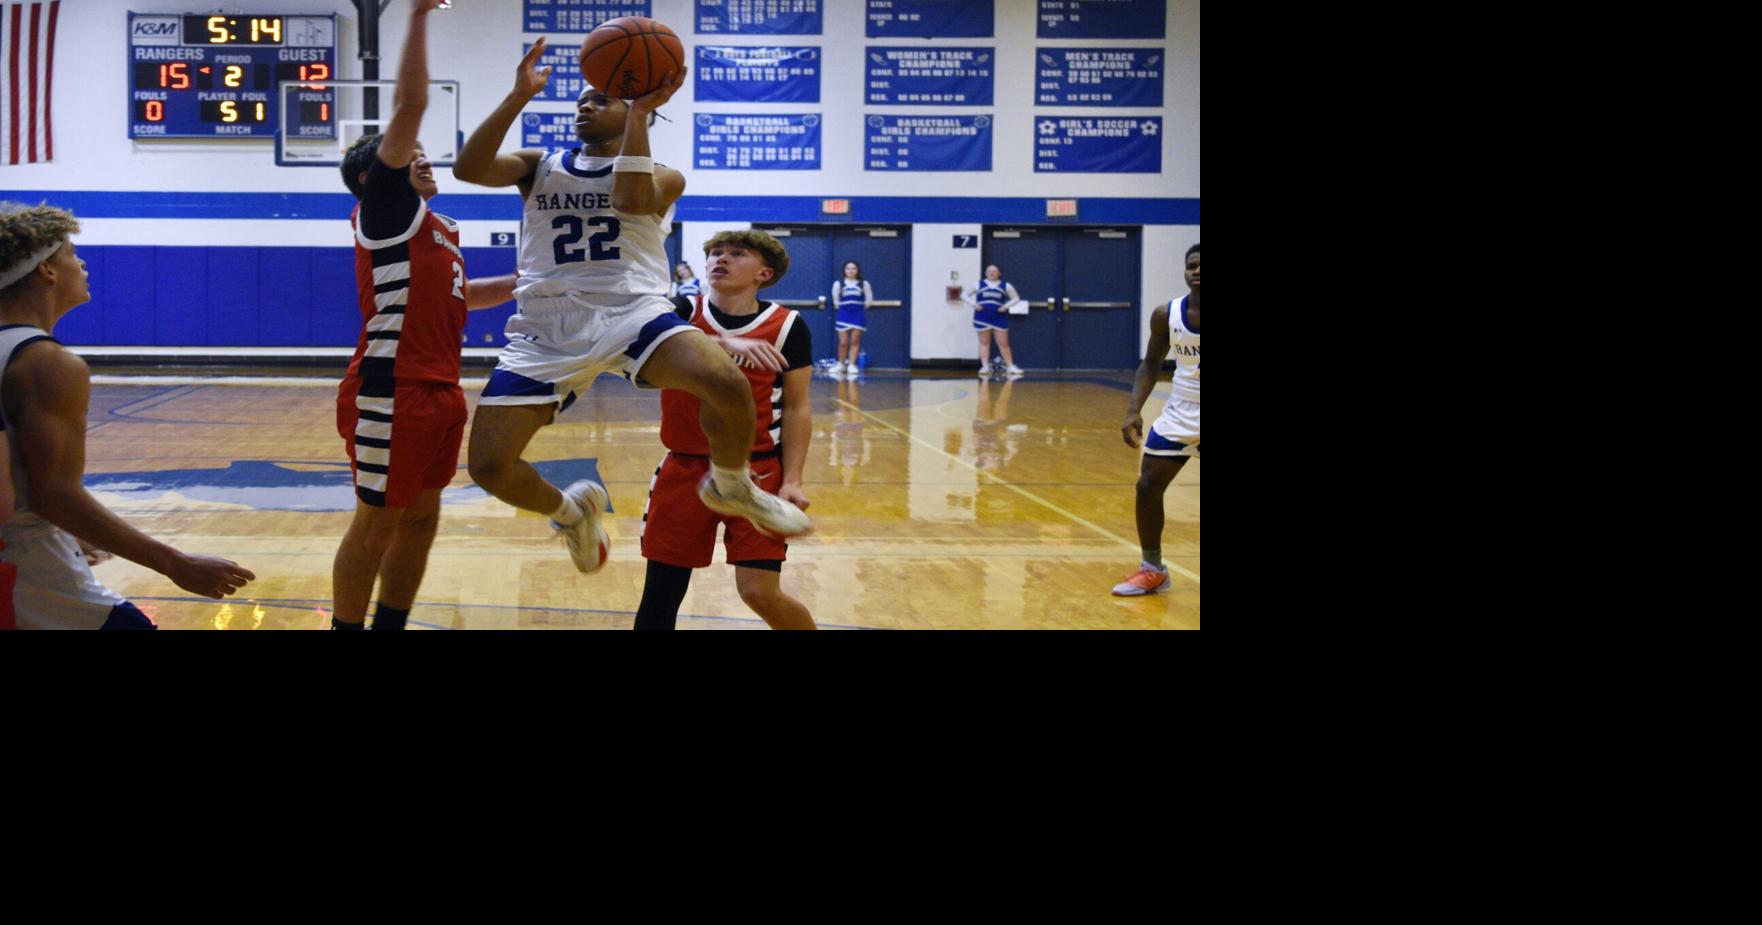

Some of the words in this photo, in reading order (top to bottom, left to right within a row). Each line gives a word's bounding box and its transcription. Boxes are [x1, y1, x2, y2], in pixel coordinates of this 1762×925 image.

[134, 22, 178, 35] K&M
[207, 16, 281, 43] 5:14
[135, 48, 205, 60] RANGERS
[278, 49, 328, 61] GUEST
[887, 51, 937, 60] WOMEN'S
[940, 51, 974, 60] TRACK
[1065, 52, 1099, 61] MEN'S
[1102, 52, 1135, 61] TRACK
[215, 55, 252, 63] PERIOD
[898, 60, 961, 68] CHAMPIONS
[1068, 61, 1131, 69] CHAMPIONS
[159, 63, 189, 88] 15
[224, 65, 242, 87] 2
[300, 64, 329, 90] 12
[134, 92, 168, 100] FOULS
[198, 92, 237, 101] PLAYER
[242, 92, 268, 101] FOUL
[299, 93, 332, 101] FOULS
[146, 101, 163, 121] 0
[220, 101, 238, 122] 5
[255, 102, 265, 121] 1
[320, 103, 328, 121] 1
[725, 117, 790, 125] BASKETBALL
[897, 119, 962, 127] BASKETBALL
[1059, 120, 1093, 128] GIRL'S
[1097, 120, 1137, 128] SOCCER
[133, 126, 167, 134] SCORE
[215, 126, 251, 134] MATCH
[299, 126, 332, 135] SCORE
[709, 125, 740, 134] GIRLS
[743, 125, 806, 134] CHAMPIONS
[881, 127, 912, 135] GIRLS
[915, 127, 977, 136] CHAMPIONS
[1067, 128, 1130, 137] CHAMPIONS
[536, 193, 611, 211] RANGE
[498, 234, 509, 245] 9
[551, 215, 621, 265] 22
[960, 236, 970, 247] 7
